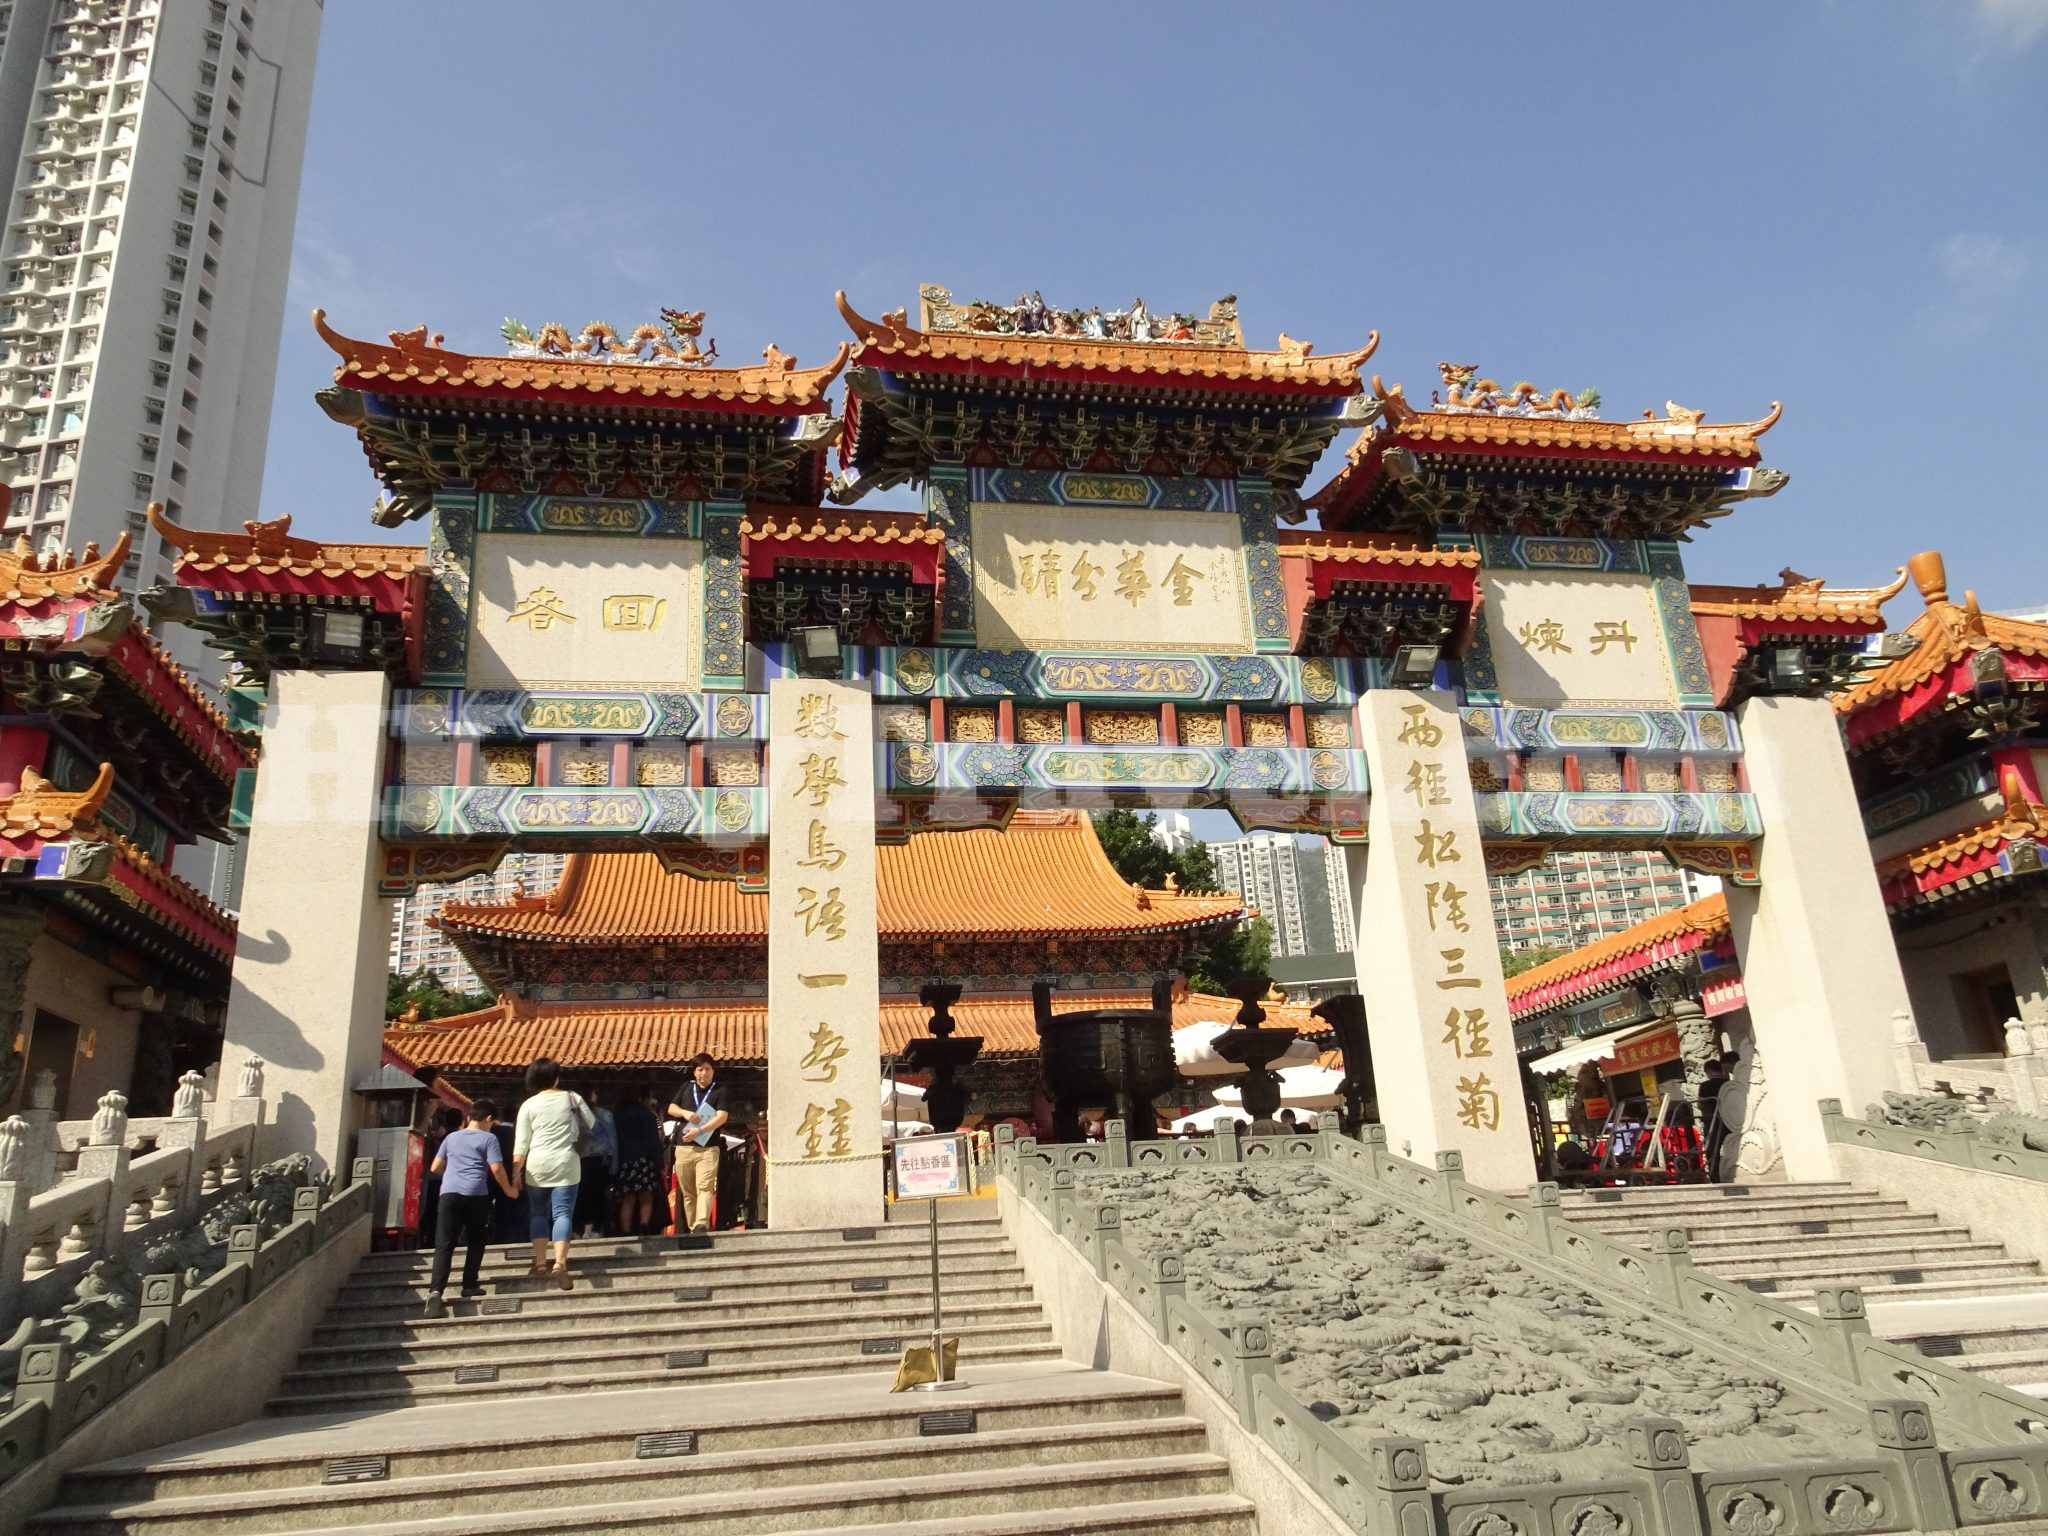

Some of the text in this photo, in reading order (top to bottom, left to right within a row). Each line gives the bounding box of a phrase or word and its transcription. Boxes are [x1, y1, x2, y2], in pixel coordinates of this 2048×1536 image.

[900, 1154, 952, 1172] 先往點香區
